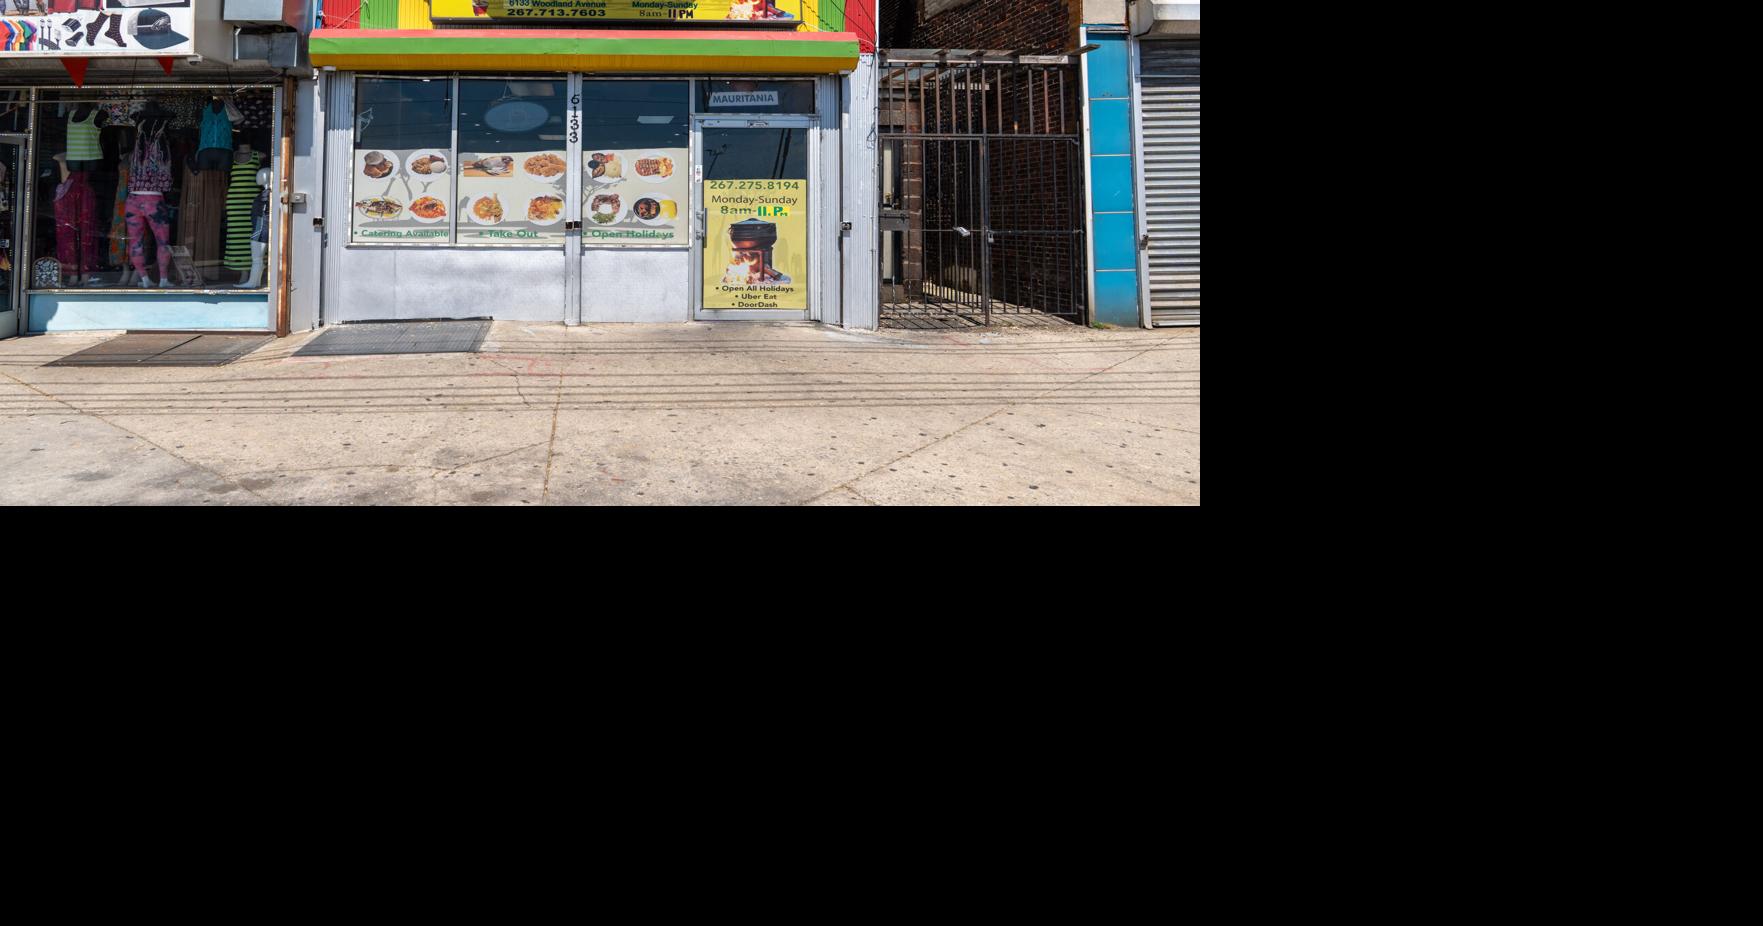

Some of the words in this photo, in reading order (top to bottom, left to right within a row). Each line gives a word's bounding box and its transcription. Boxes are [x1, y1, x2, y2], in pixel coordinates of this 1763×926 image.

[632, 1, 698, 9] Monday-Sunday
[713, 94, 774, 104] MAURITANIA
[569, 94, 580, 143] 6133
[710, 181, 800, 190] 267.275.8194
[712, 196, 798, 206] Monday-Sunday
[362, 230, 402, 238] Catering
[592, 230, 621, 239] Open
[626, 230, 674, 239] Holidays
